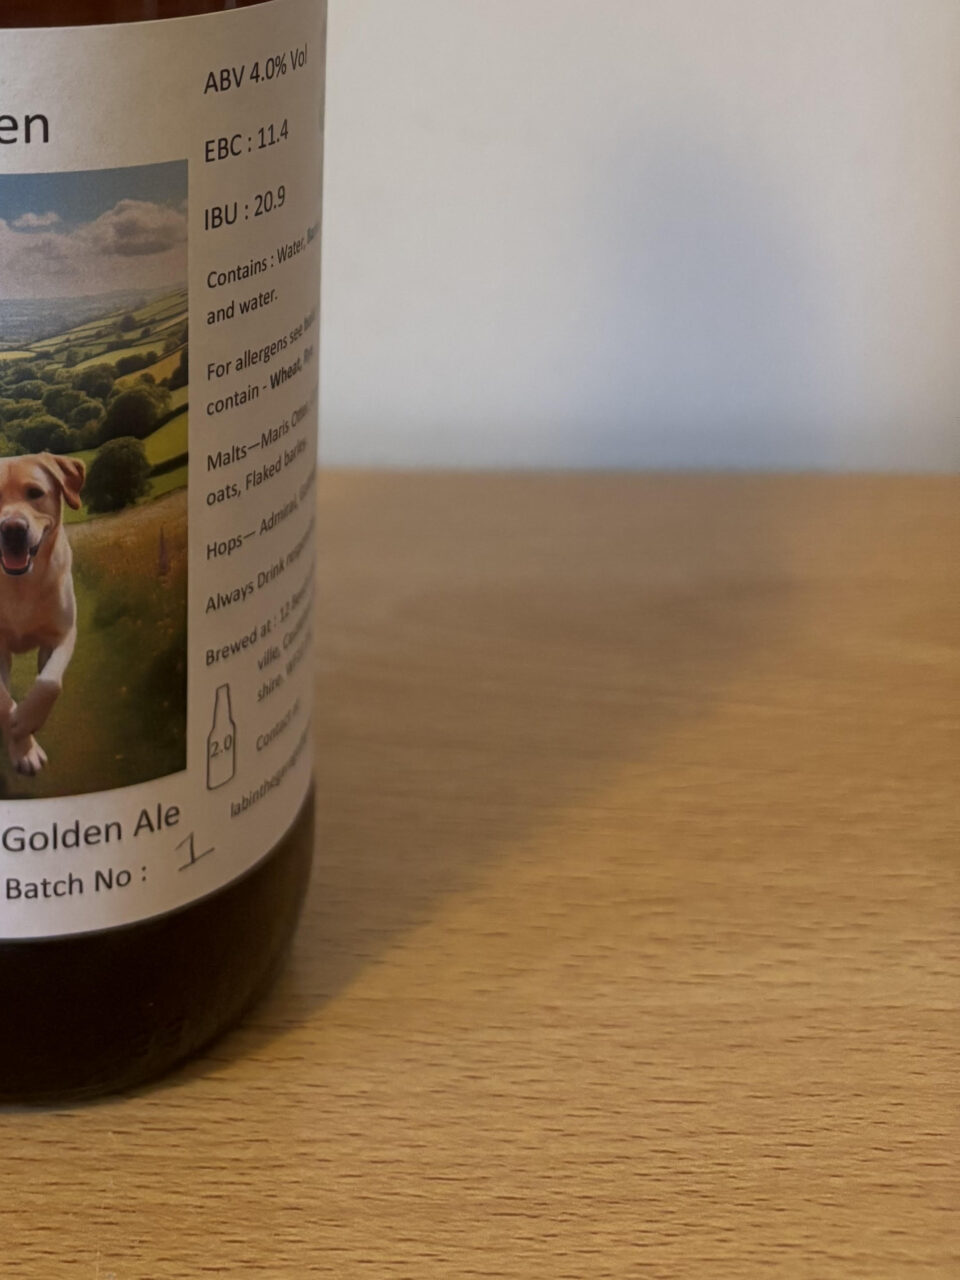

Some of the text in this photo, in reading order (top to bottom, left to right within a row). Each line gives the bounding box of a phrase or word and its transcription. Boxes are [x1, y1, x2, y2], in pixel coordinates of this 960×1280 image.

[204, 43, 308, 94] ABV 4.0% Vol
[205, 134, 242, 163] EBC
[257, 118, 289, 150] 11.4
[204, 202, 238, 231] IBU
[254, 185, 286, 217] 20.9
[207, 257, 267, 289] Contains
[276, 236, 306, 265] Water,
[207, 287, 279, 325] and water.
[207, 360, 232, 381] For
[235, 335, 288, 372] allergens
[289, 323, 304, 345] see
[206, 384, 259, 417] contain
[206, 483, 242, 507] oats,
[246, 456, 282, 491] Flaked
[205, 581, 254, 614] Always
[257, 556, 285, 589] Drink
[205, 626, 258, 667] Brewed
[260, 619, 271, 638] at
[210, 734, 232, 758] 2.0
[2, 820, 122, 853] Golden
[132, 802, 181, 838] Ale
[175, 831, 215, 872] 1
[5, 872, 84, 900] Batch
[95, 867, 132, 893] No
